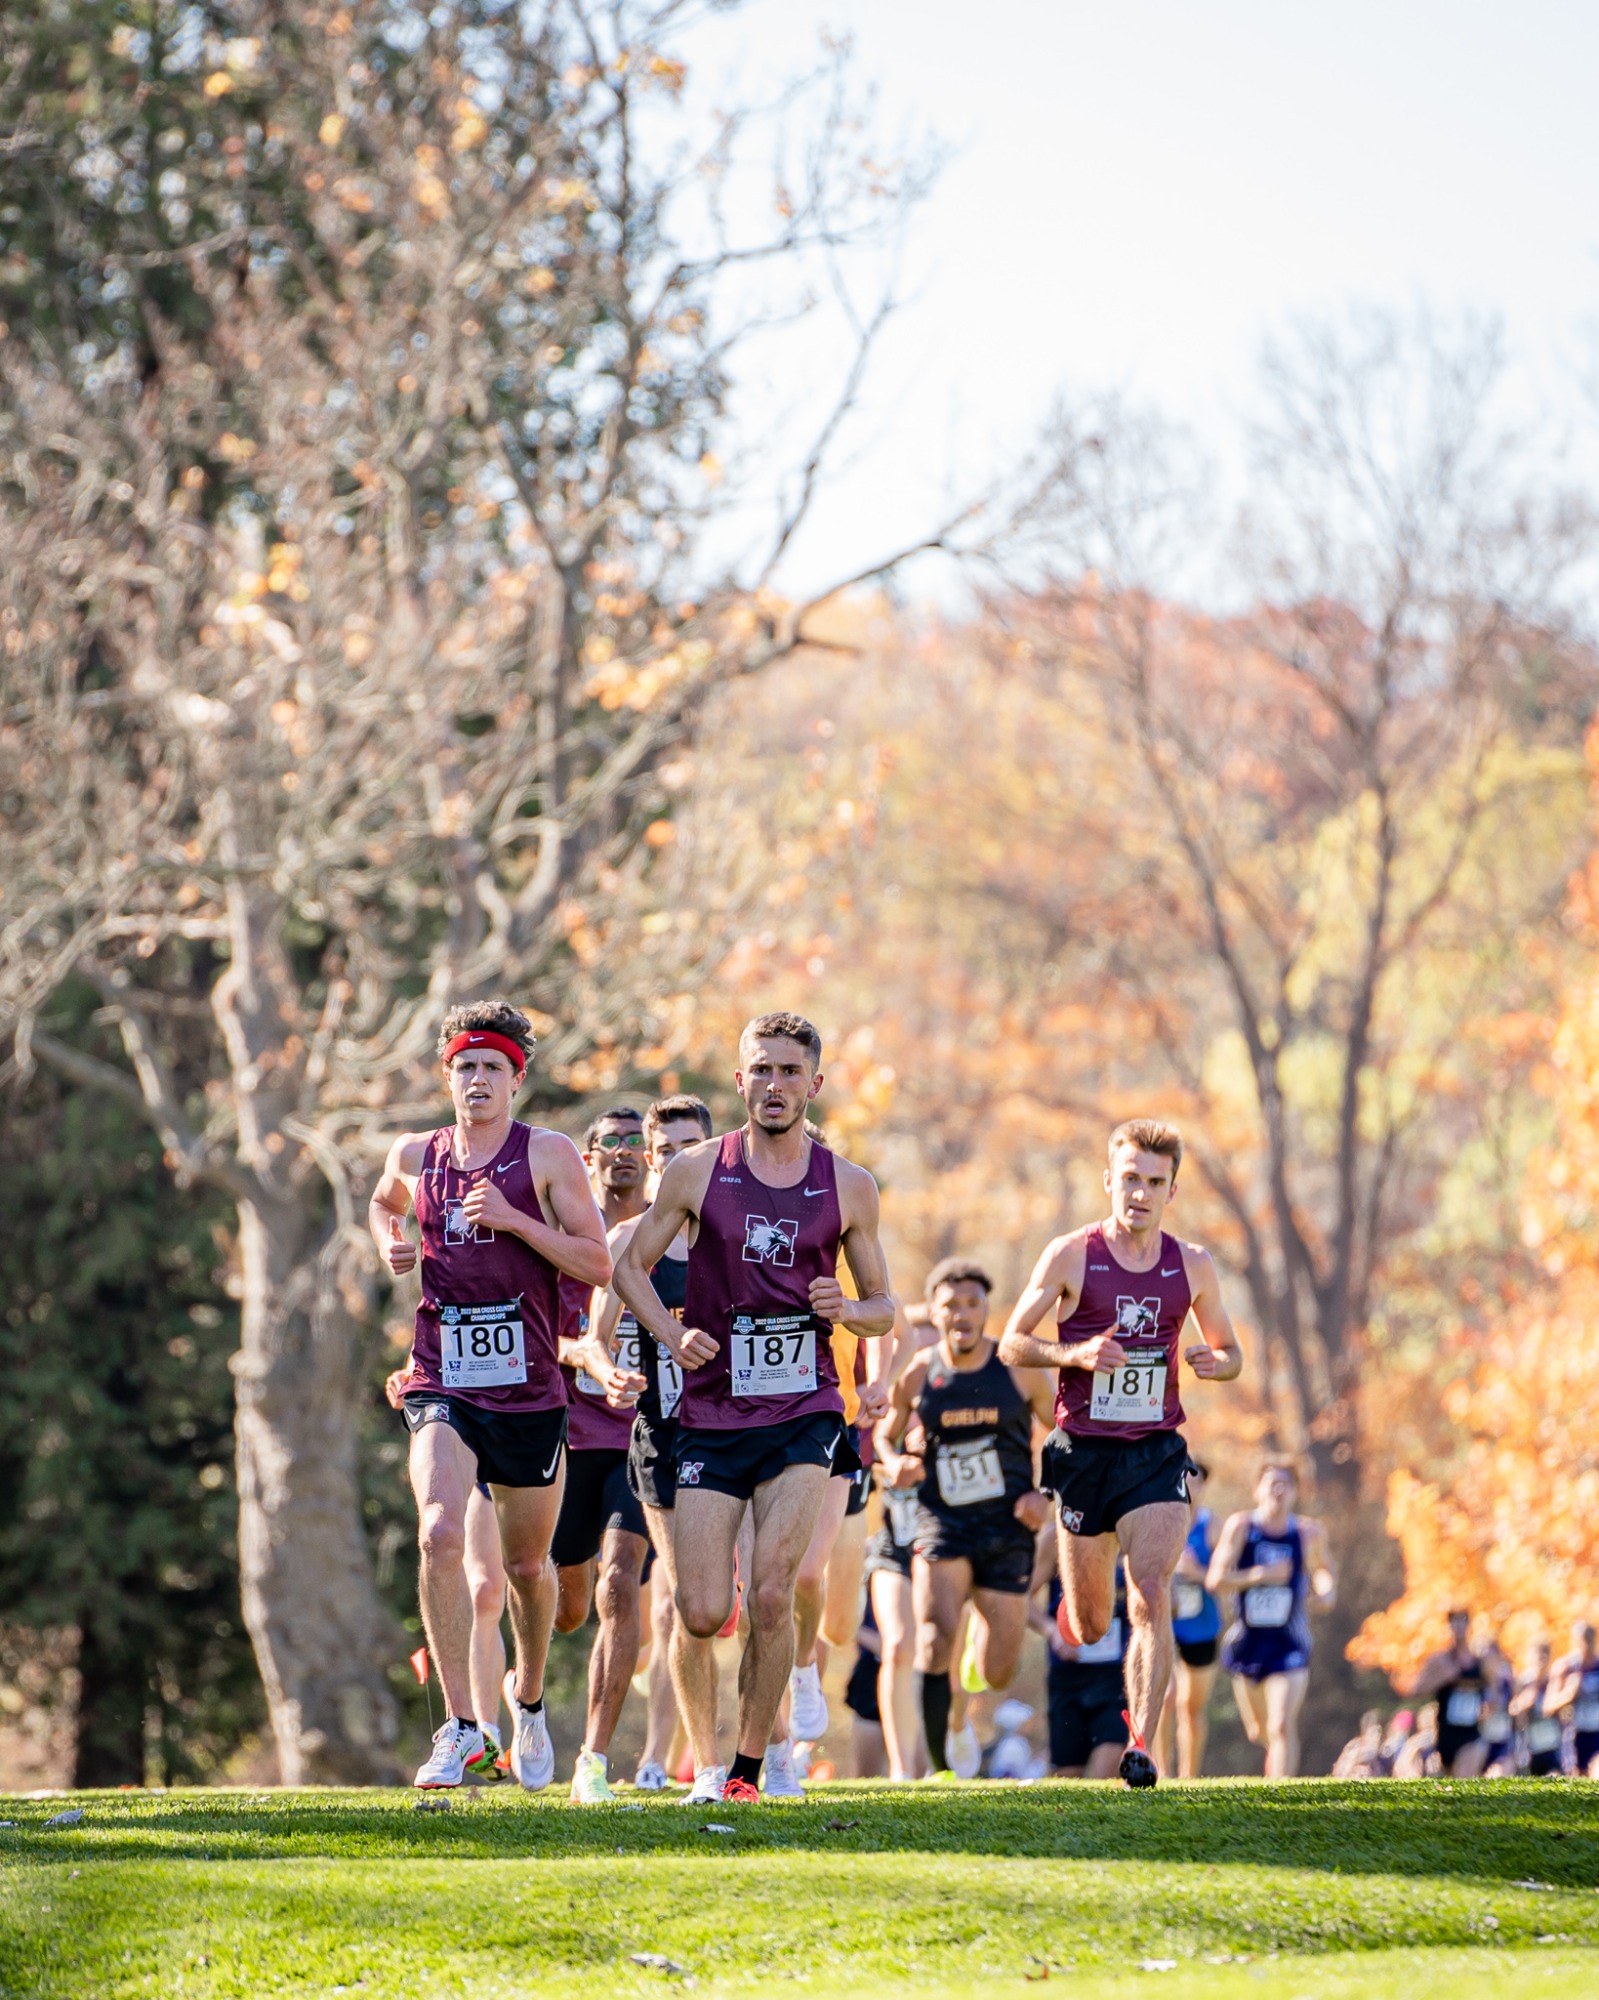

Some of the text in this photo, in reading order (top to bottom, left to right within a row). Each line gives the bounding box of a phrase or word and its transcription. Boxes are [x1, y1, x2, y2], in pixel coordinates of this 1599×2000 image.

[452, 1325, 514, 1357] 180
[744, 1334, 804, 1366] 187
[1108, 1369, 1154, 1396] 181
[948, 1453, 988, 1485] 151
